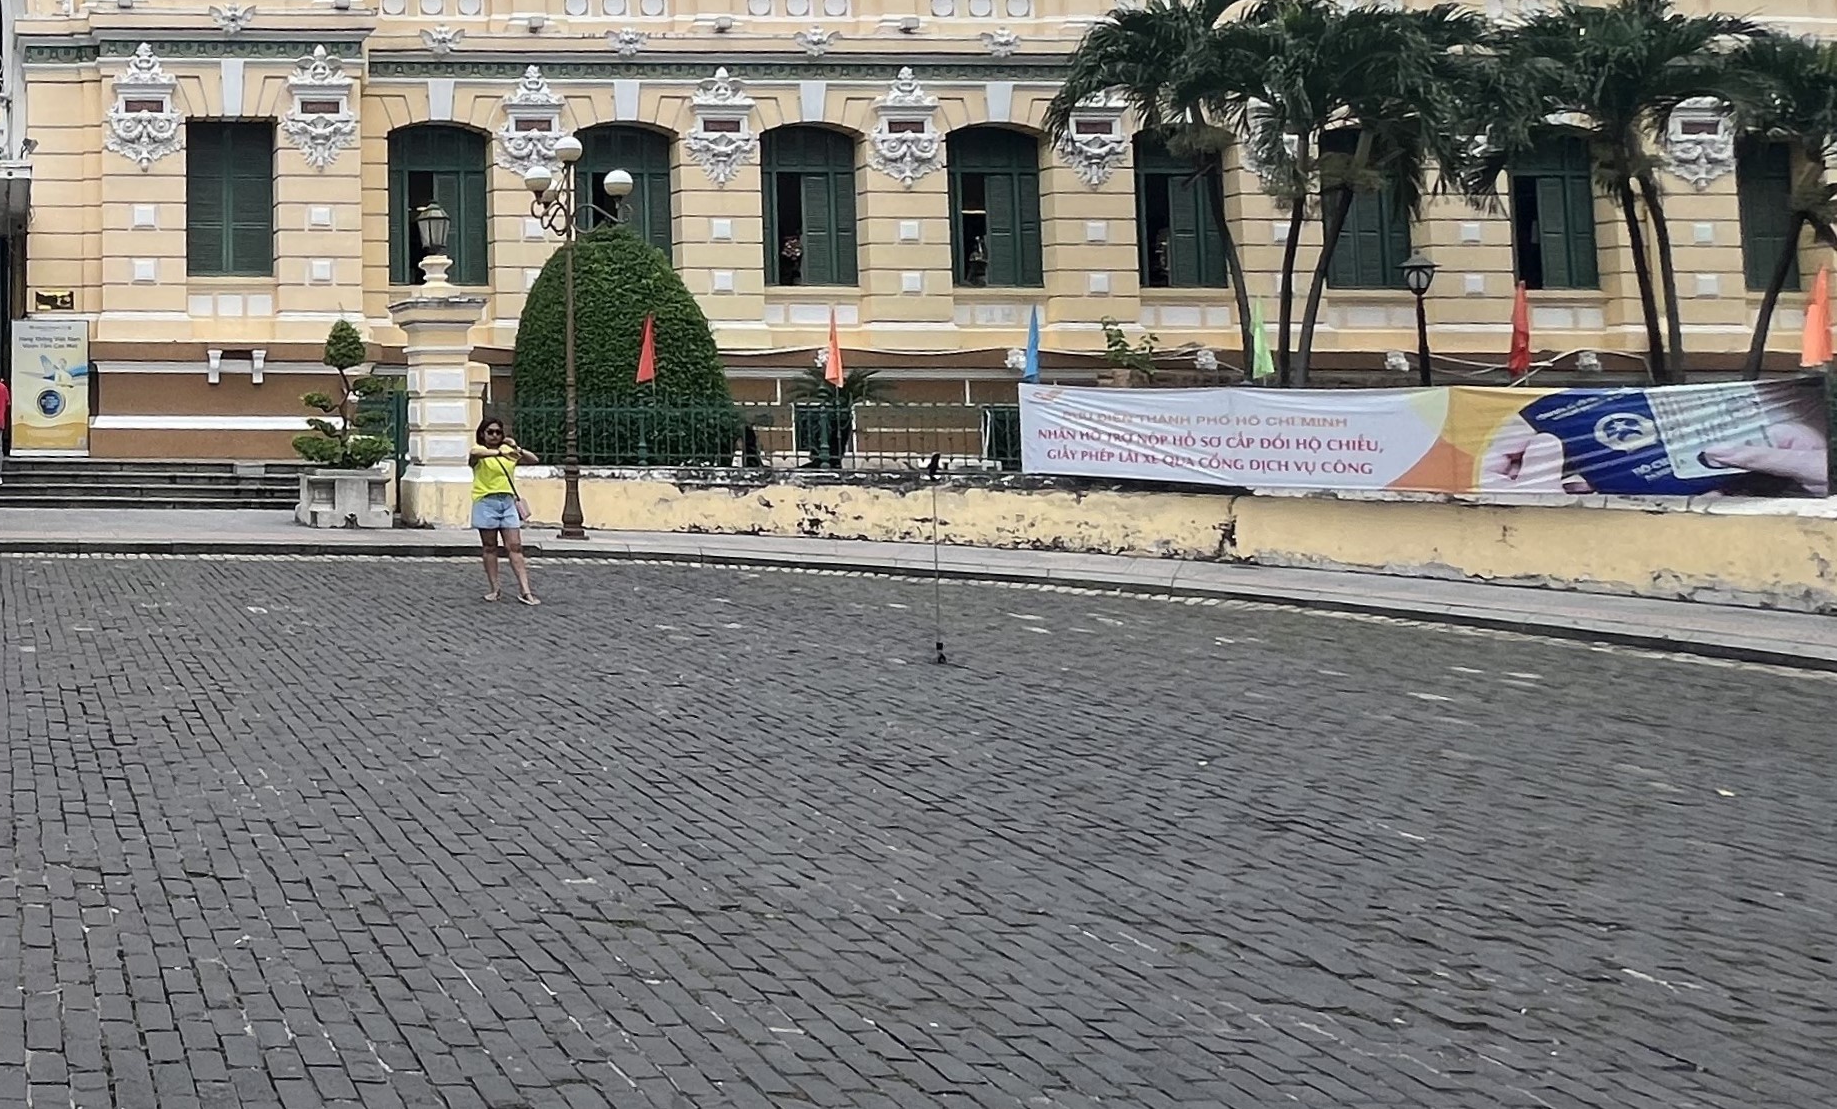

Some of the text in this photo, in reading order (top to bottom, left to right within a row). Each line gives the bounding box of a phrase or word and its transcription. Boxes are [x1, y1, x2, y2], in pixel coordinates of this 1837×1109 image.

[1196, 413, 1231, 426] PHỐ
[1300, 416, 1348, 428] MINH
[1200, 436, 1223, 448] SƠ
[1295, 437, 1322, 453] HỘ
[1326, 433, 1385, 453] CHIẾU,
[1081, 447, 1116, 462] PHÉP
[1162, 454, 1195, 468] QUA
[1249, 459, 1290, 474] DỊCH
[1293, 461, 1317, 476] VỤ
[1321, 459, 1374, 475] CÔNG
